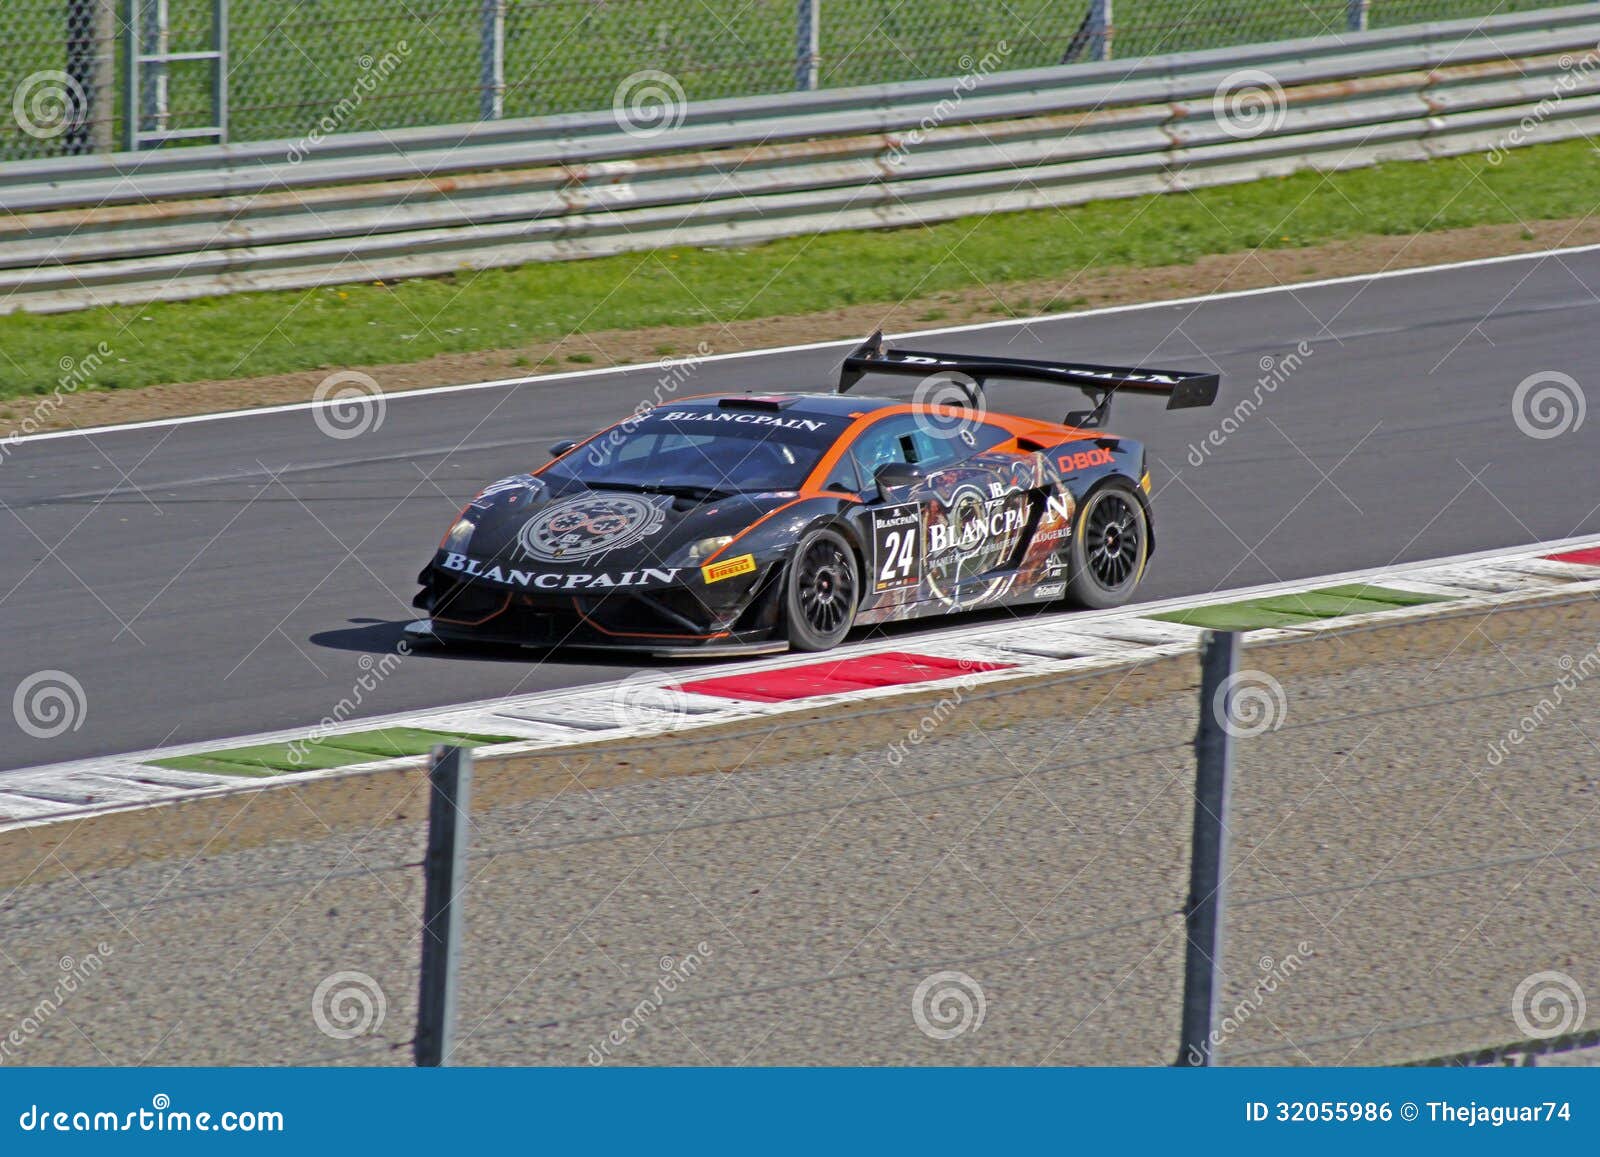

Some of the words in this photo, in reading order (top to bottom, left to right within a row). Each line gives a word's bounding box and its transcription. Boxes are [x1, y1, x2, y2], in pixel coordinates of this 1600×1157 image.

[661, 411, 827, 432] BLANCPAIN
[877, 513, 918, 529] BLANCPAIN
[880, 528, 915, 581] 24
[441, 551, 683, 590] BLANCPAIN
[709, 558, 750, 579] PIRELLI
